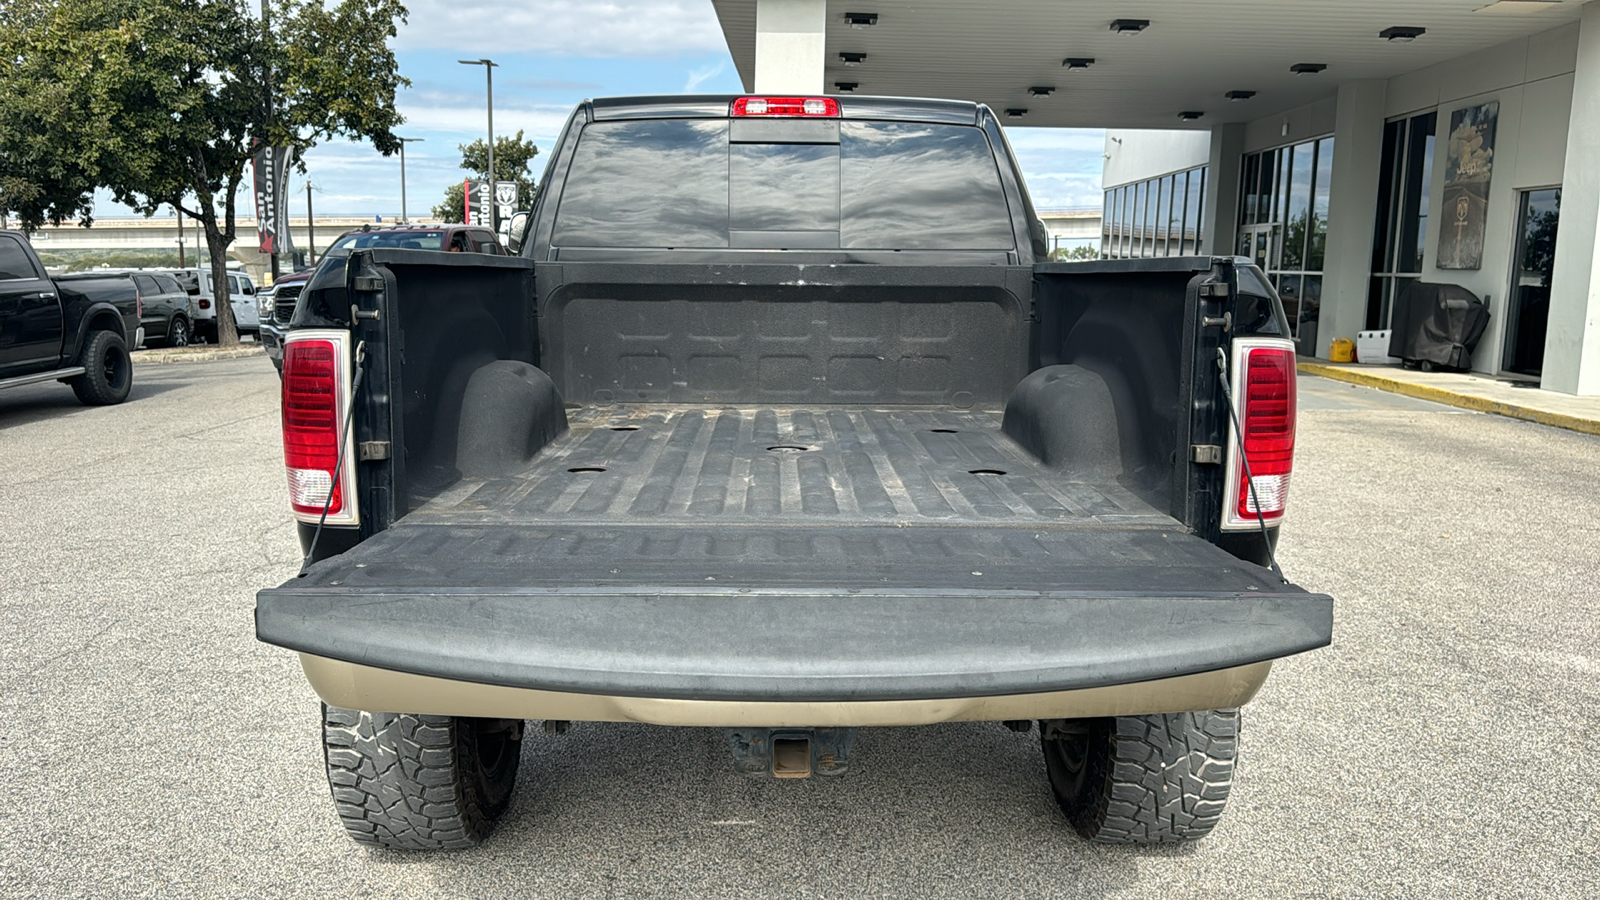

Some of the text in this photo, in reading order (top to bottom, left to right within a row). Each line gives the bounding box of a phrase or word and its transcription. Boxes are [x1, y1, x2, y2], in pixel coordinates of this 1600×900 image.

[1456, 161, 1477, 176] Jeep
[263, 146, 276, 234] Antonio
[478, 184, 490, 227] ntonio
[257, 191, 267, 233] San
[469, 211, 479, 227] an
